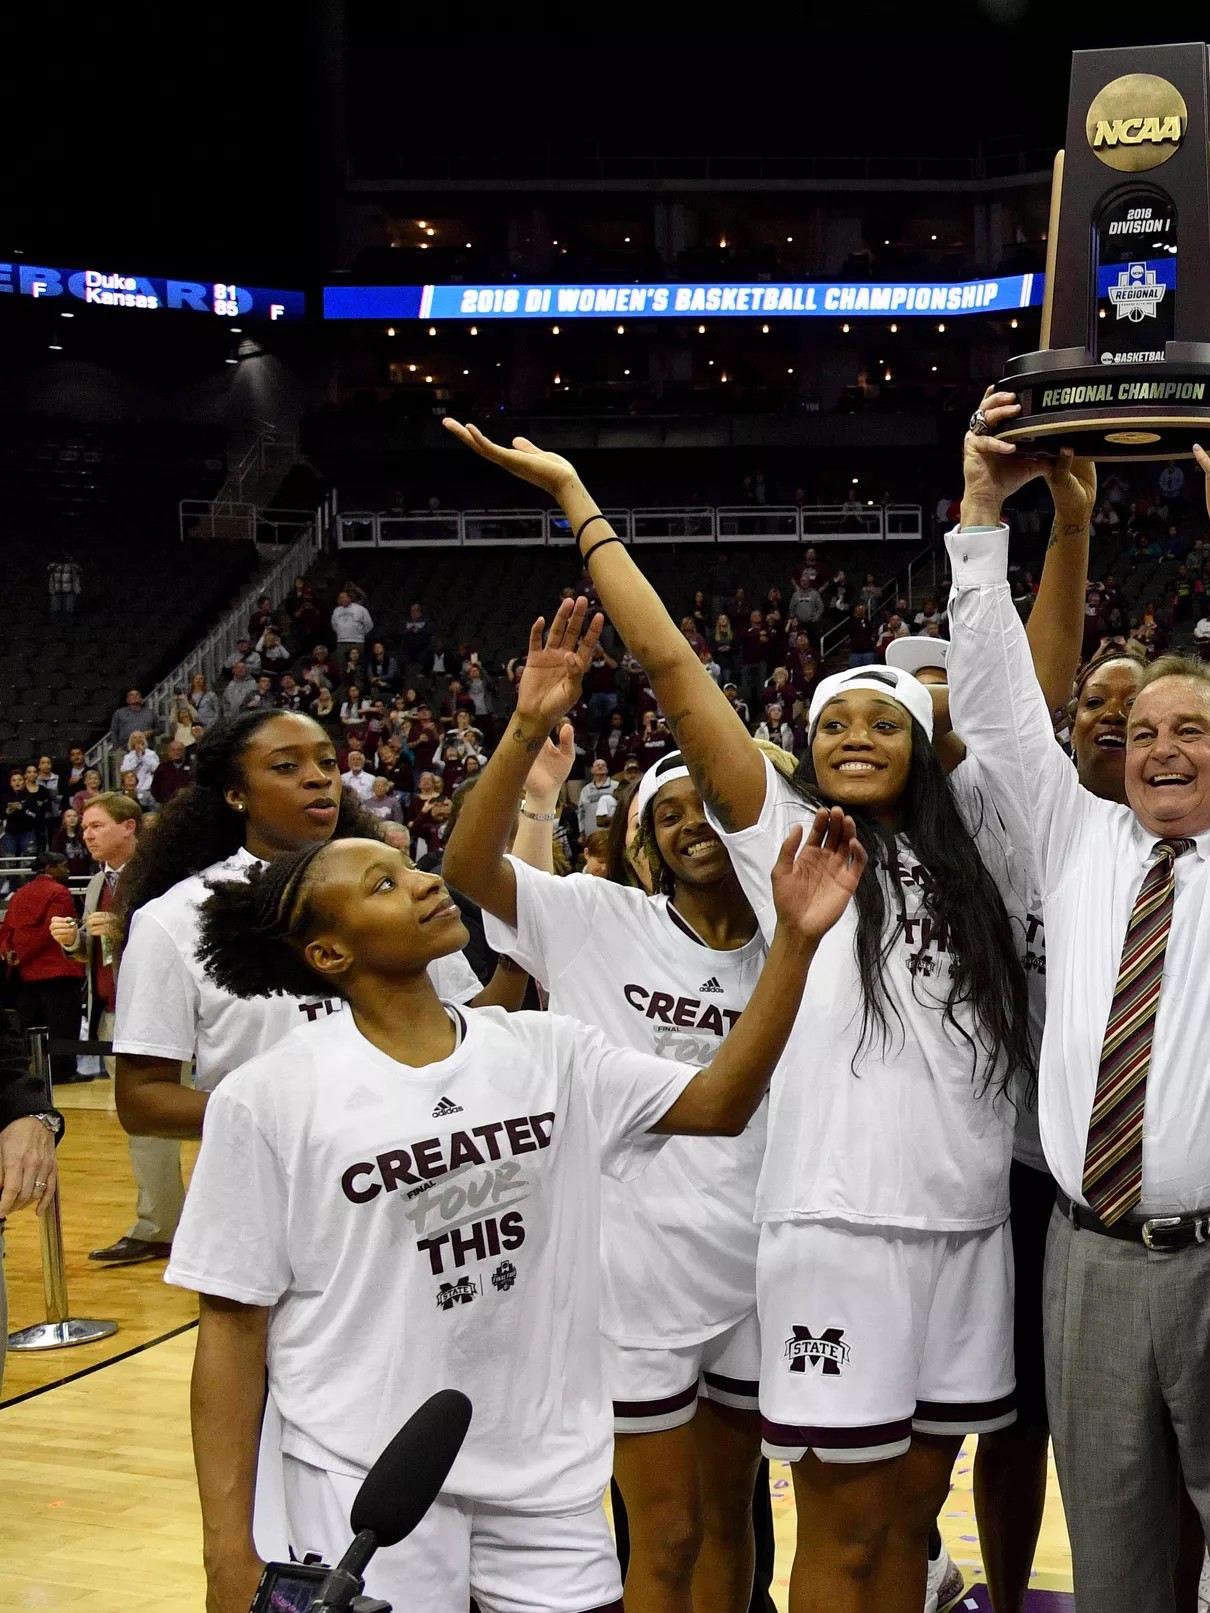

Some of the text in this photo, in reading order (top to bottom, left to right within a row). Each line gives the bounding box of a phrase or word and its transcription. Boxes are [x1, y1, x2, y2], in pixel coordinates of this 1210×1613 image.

[1093, 115, 1181, 148] NCAA
[1126, 208, 1152, 221] 2018
[1108, 219, 1162, 235] DIVISION
[33, 282, 48, 298] F
[86, 270, 237, 300] Duke 81
[1115, 288, 1158, 300] REGIONAL
[86, 286, 239, 316] Kansas 85
[460, 282, 998, 313] 2018 DI WOMEN'S BASKETBALL CHAMPIONSHIP
[270, 304, 285, 320] F
[1114, 351, 1166, 363] BASKETBAL
[1042, 382, 1206, 407] REGIONAL CHAMPION
[624, 983, 743, 1036] CREAT
[431, 1105, 464, 1119] adidas
[341, 1111, 556, 1205] CREATED
[406, 1179, 437, 1199] FINAL
[416, 1211, 526, 1276] THIS
[442, 1285, 469, 1301] STATE
[793, 1341, 839, 1359] STATE
